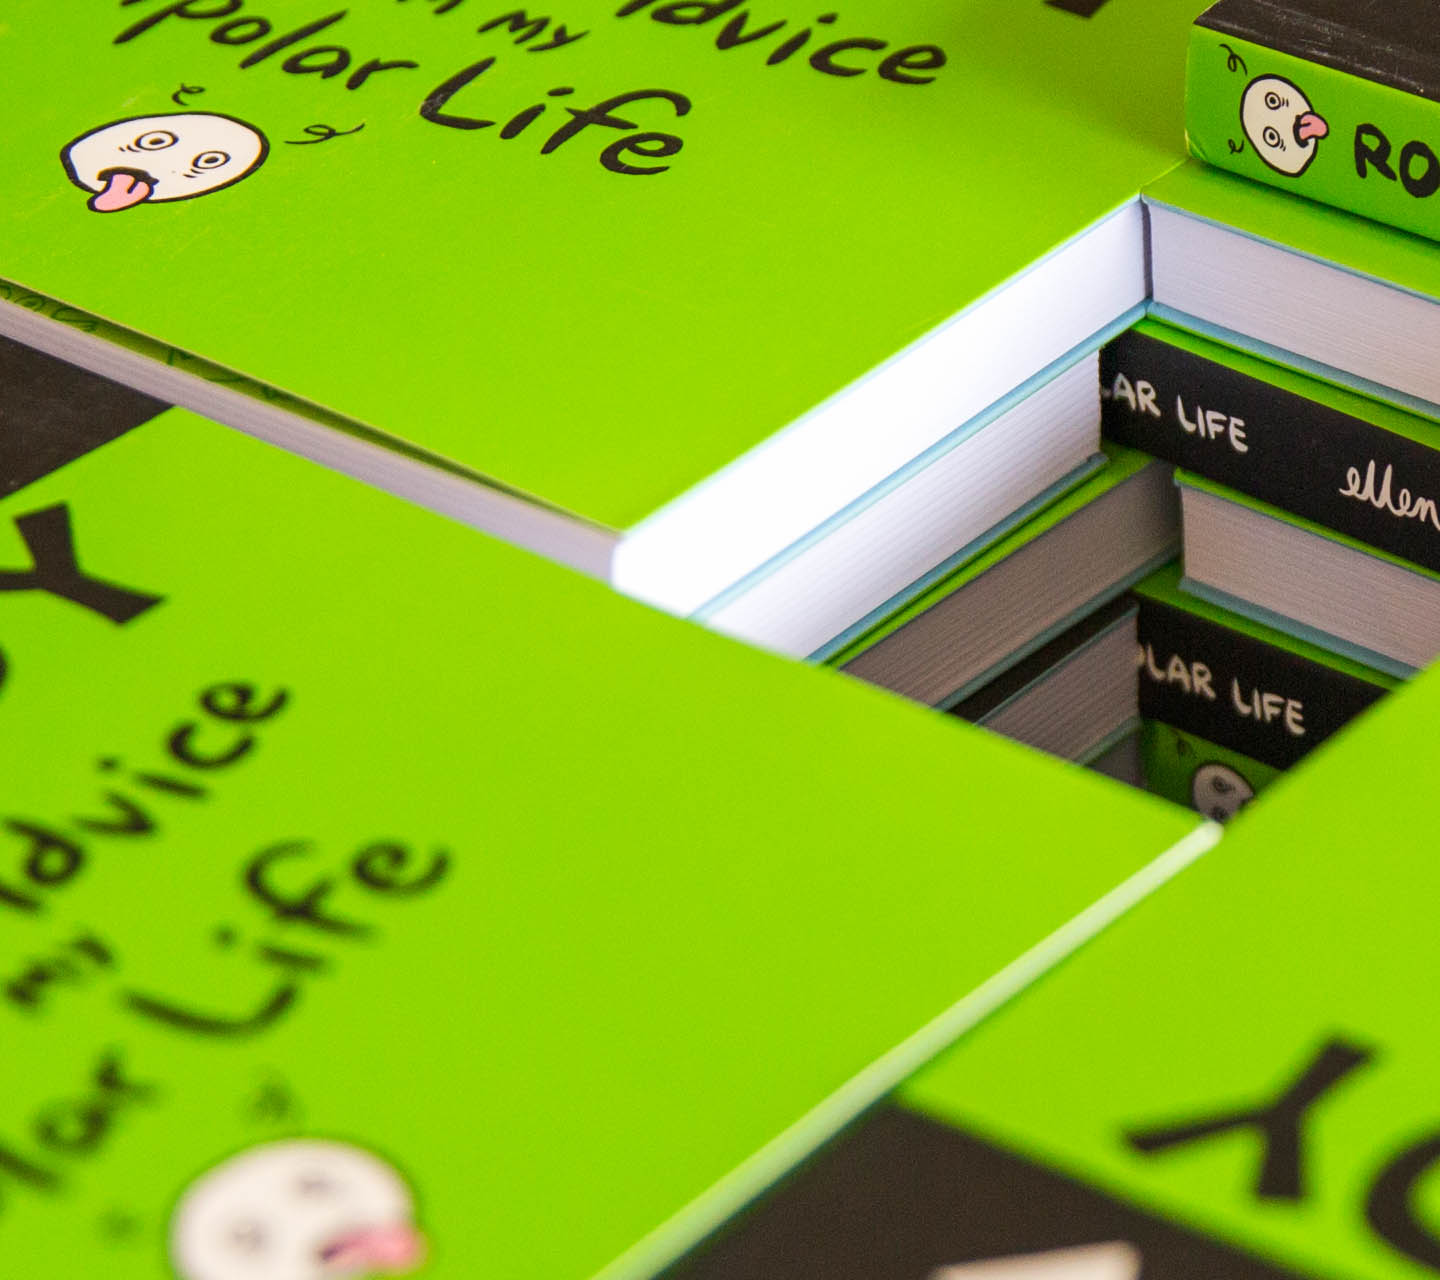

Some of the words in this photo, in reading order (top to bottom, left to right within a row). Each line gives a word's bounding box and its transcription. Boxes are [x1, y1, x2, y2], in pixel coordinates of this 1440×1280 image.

[477, 6, 593, 52] MY
[419, 53, 693, 177] Life
[1177, 395, 1249, 453] LIFE
[1233, 678, 1306, 736] LIFE
[126, 828, 454, 1039] Life
